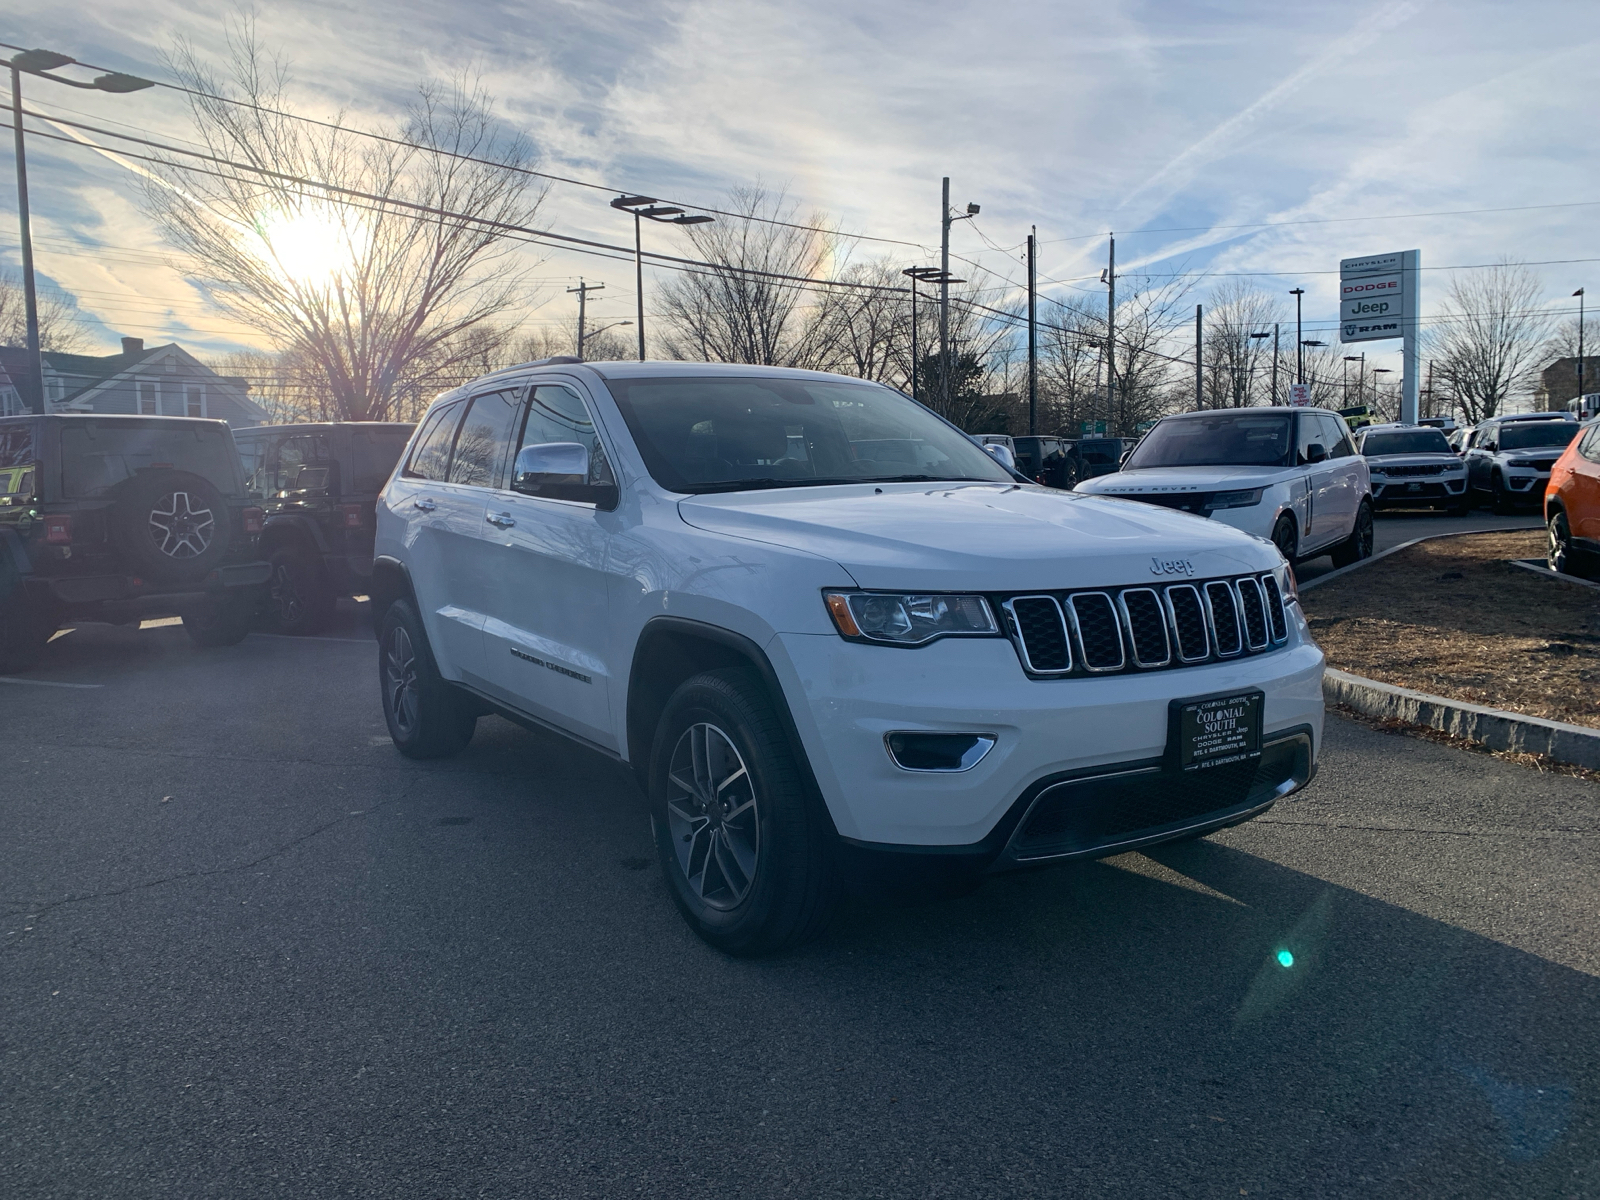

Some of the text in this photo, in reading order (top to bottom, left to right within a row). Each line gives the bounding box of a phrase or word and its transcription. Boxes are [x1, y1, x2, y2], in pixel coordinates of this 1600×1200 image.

[1345, 258, 1396, 268] CHRYSLER
[1343, 281, 1397, 293] DODGE
[1352, 302, 1389, 314] Jeep
[1359, 323, 1397, 332] RAM
[1149, 556, 1195, 576] Jeep
[1197, 707, 1244, 723] COLONIAL
[1205, 719, 1236, 733] SOUTH
[1192, 731, 1232, 741] CHRYSLER
[1197, 739, 1222, 748] DODGE
